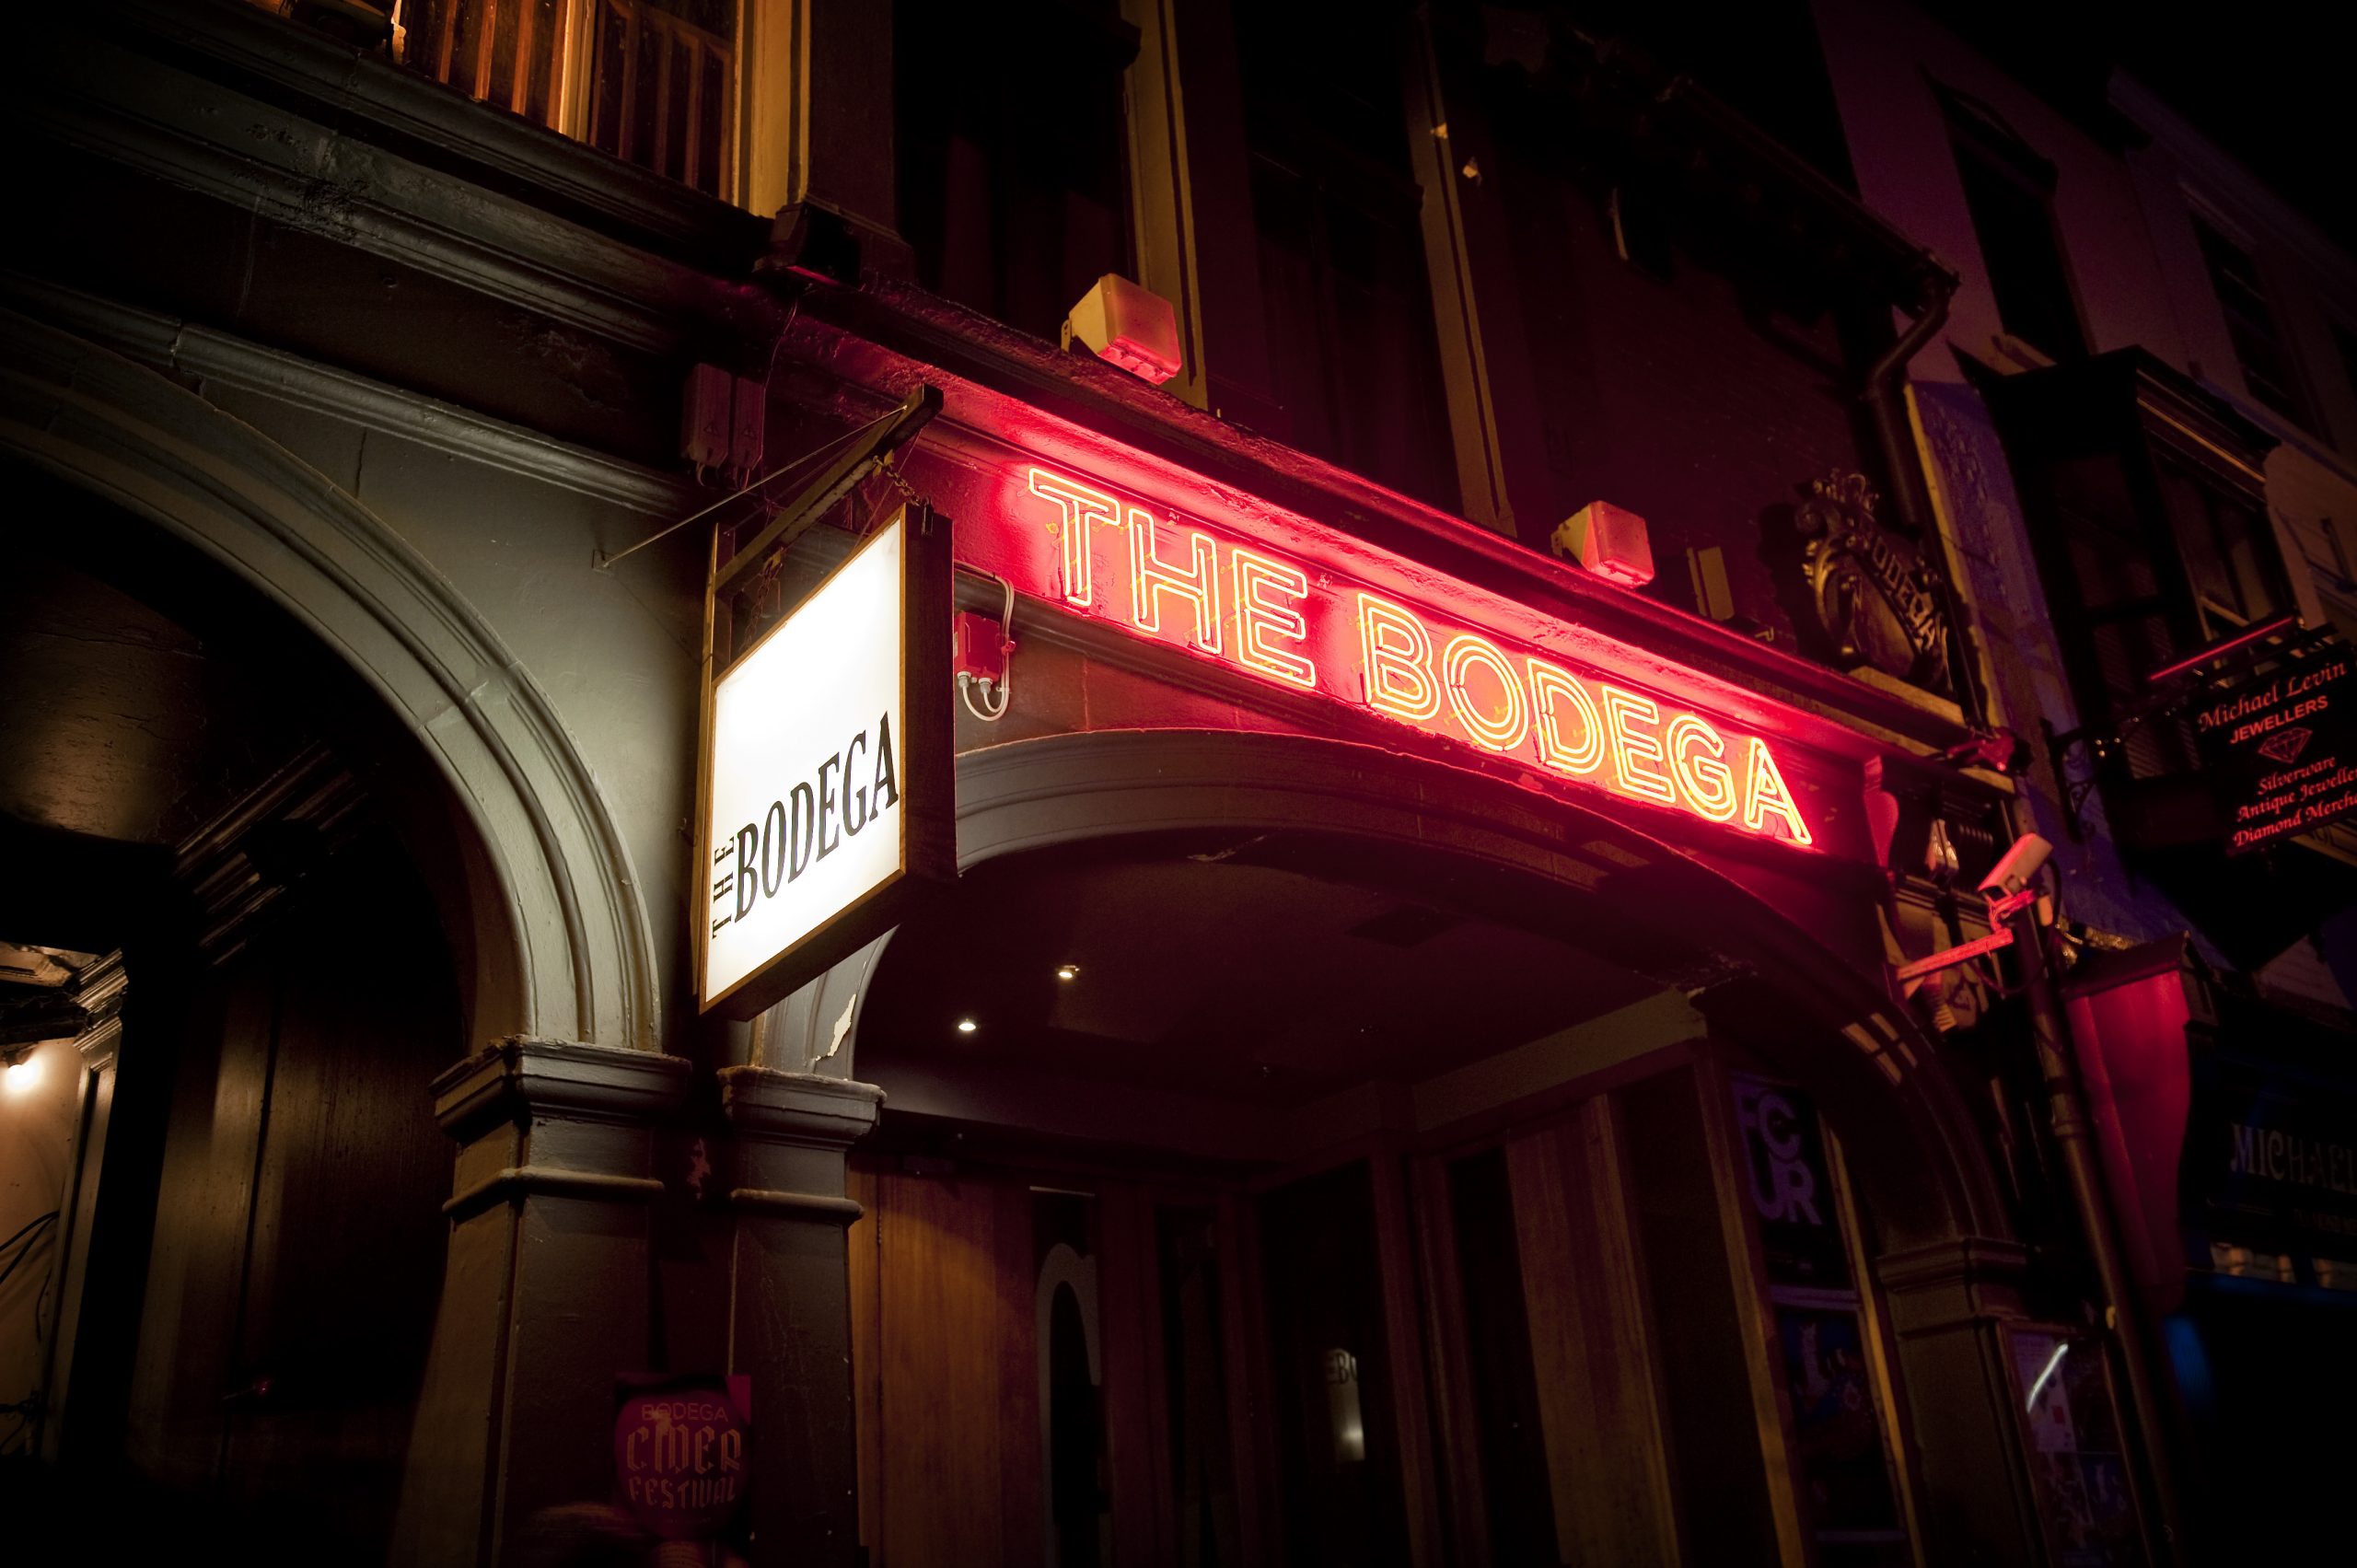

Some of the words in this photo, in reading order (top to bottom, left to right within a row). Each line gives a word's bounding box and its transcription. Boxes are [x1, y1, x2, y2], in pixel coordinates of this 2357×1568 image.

[1028, 468, 1316, 687] THE
[1357, 592, 1812, 844] BODEGA
[2197, 679, 2281, 734] Michael
[2285, 662, 2348, 698] Levin
[2229, 694, 2329, 745] JEWELLERS
[2235, 791, 2296, 822] Antique
[2299, 765, 2357, 802] Jewelle
[2257, 756, 2337, 796] Silverware
[734, 710, 899, 923] BODEGA
[2233, 807, 2303, 848] Diamond
[712, 836, 735, 939] THE
[641, 1401, 729, 1423] BODEGA
[628, 1474, 738, 1510] FESTIVAL
